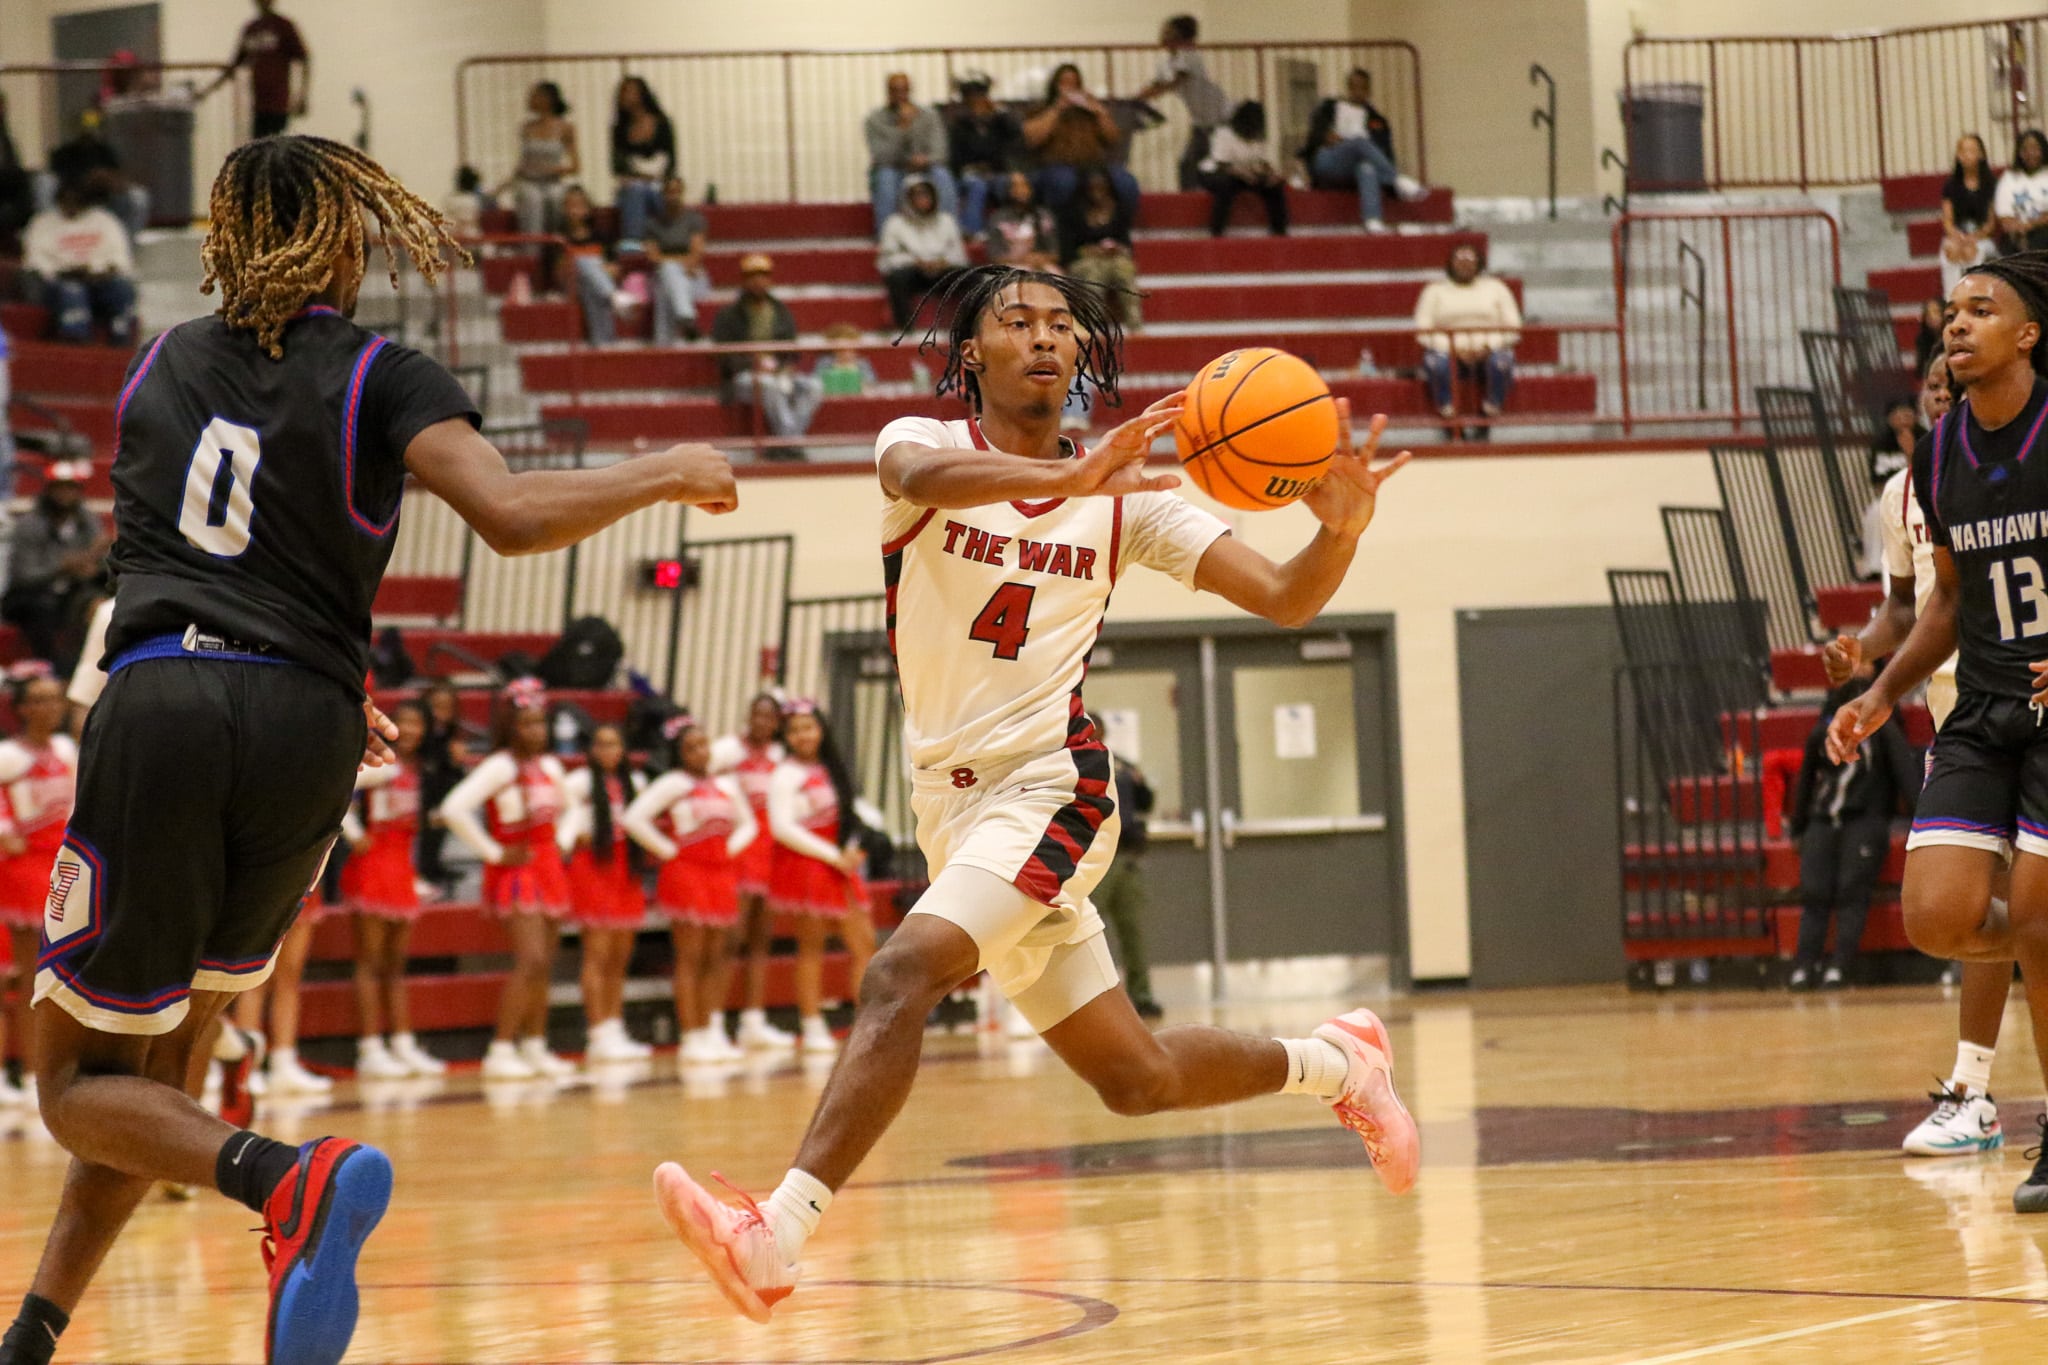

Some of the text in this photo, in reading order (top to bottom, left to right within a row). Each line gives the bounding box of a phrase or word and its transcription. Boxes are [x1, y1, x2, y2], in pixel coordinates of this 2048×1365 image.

[177, 414, 262, 560] 0
[943, 519, 1097, 580] THE WAR
[968, 582, 1036, 661] 4
[1988, 555, 2048, 642] 13
